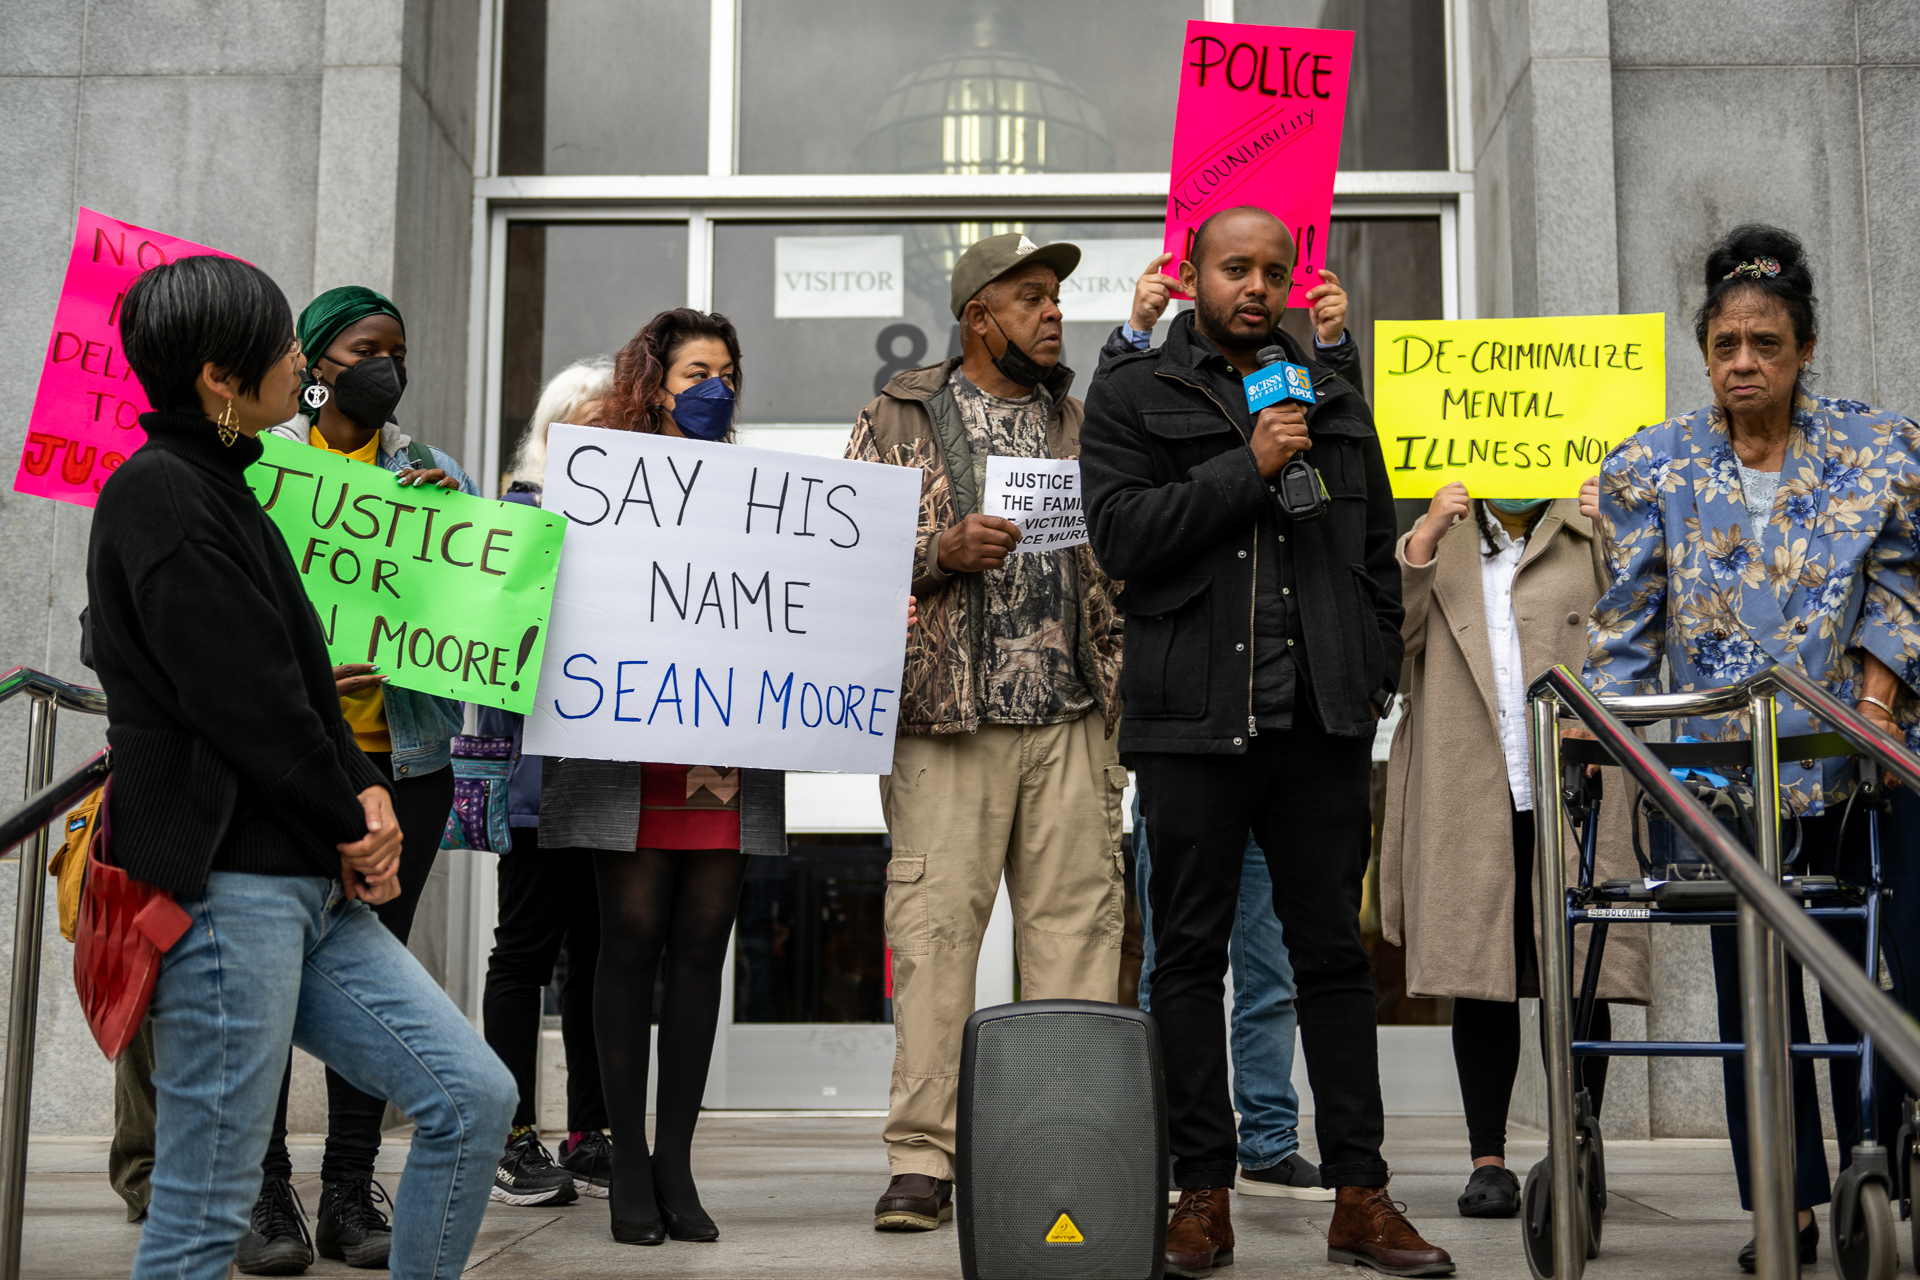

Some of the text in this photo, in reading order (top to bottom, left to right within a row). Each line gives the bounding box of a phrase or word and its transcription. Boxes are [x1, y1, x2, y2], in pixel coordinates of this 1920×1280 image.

[1189, 36, 1332, 100] POLICE
[1172, 109, 1314, 220] ACCOUNTABILITY
[783, 270, 894, 292] VISITOR
[1388, 334, 1643, 375] DE-CRIMINALIZE
[1250, 383, 1283, 402] BAY AREA
[1289, 386, 1313, 400] KPIX
[1296, 368, 1310, 390] 5
[86, 391, 140, 430] TO
[1442, 388, 1564, 420] MENTAL
[1394, 425, 1647, 472] ILLNESS NO
[563, 445, 860, 548] SAY HIS
[1005, 472, 1074, 490] JUSTICE
[257, 461, 514, 576] JUSTICE
[1002, 495, 1083, 511] THE FAMI
[1025, 516, 1086, 530] VICTIMS
[301, 537, 401, 599] FOR
[650, 561, 811, 634] NAME
[367, 615, 539, 692] MOORE!
[554, 653, 895, 737] SEAN MOORE
[1605, 909, 1650, 918] DOLOMITE
[495, 1166, 516, 1186] HOKA
